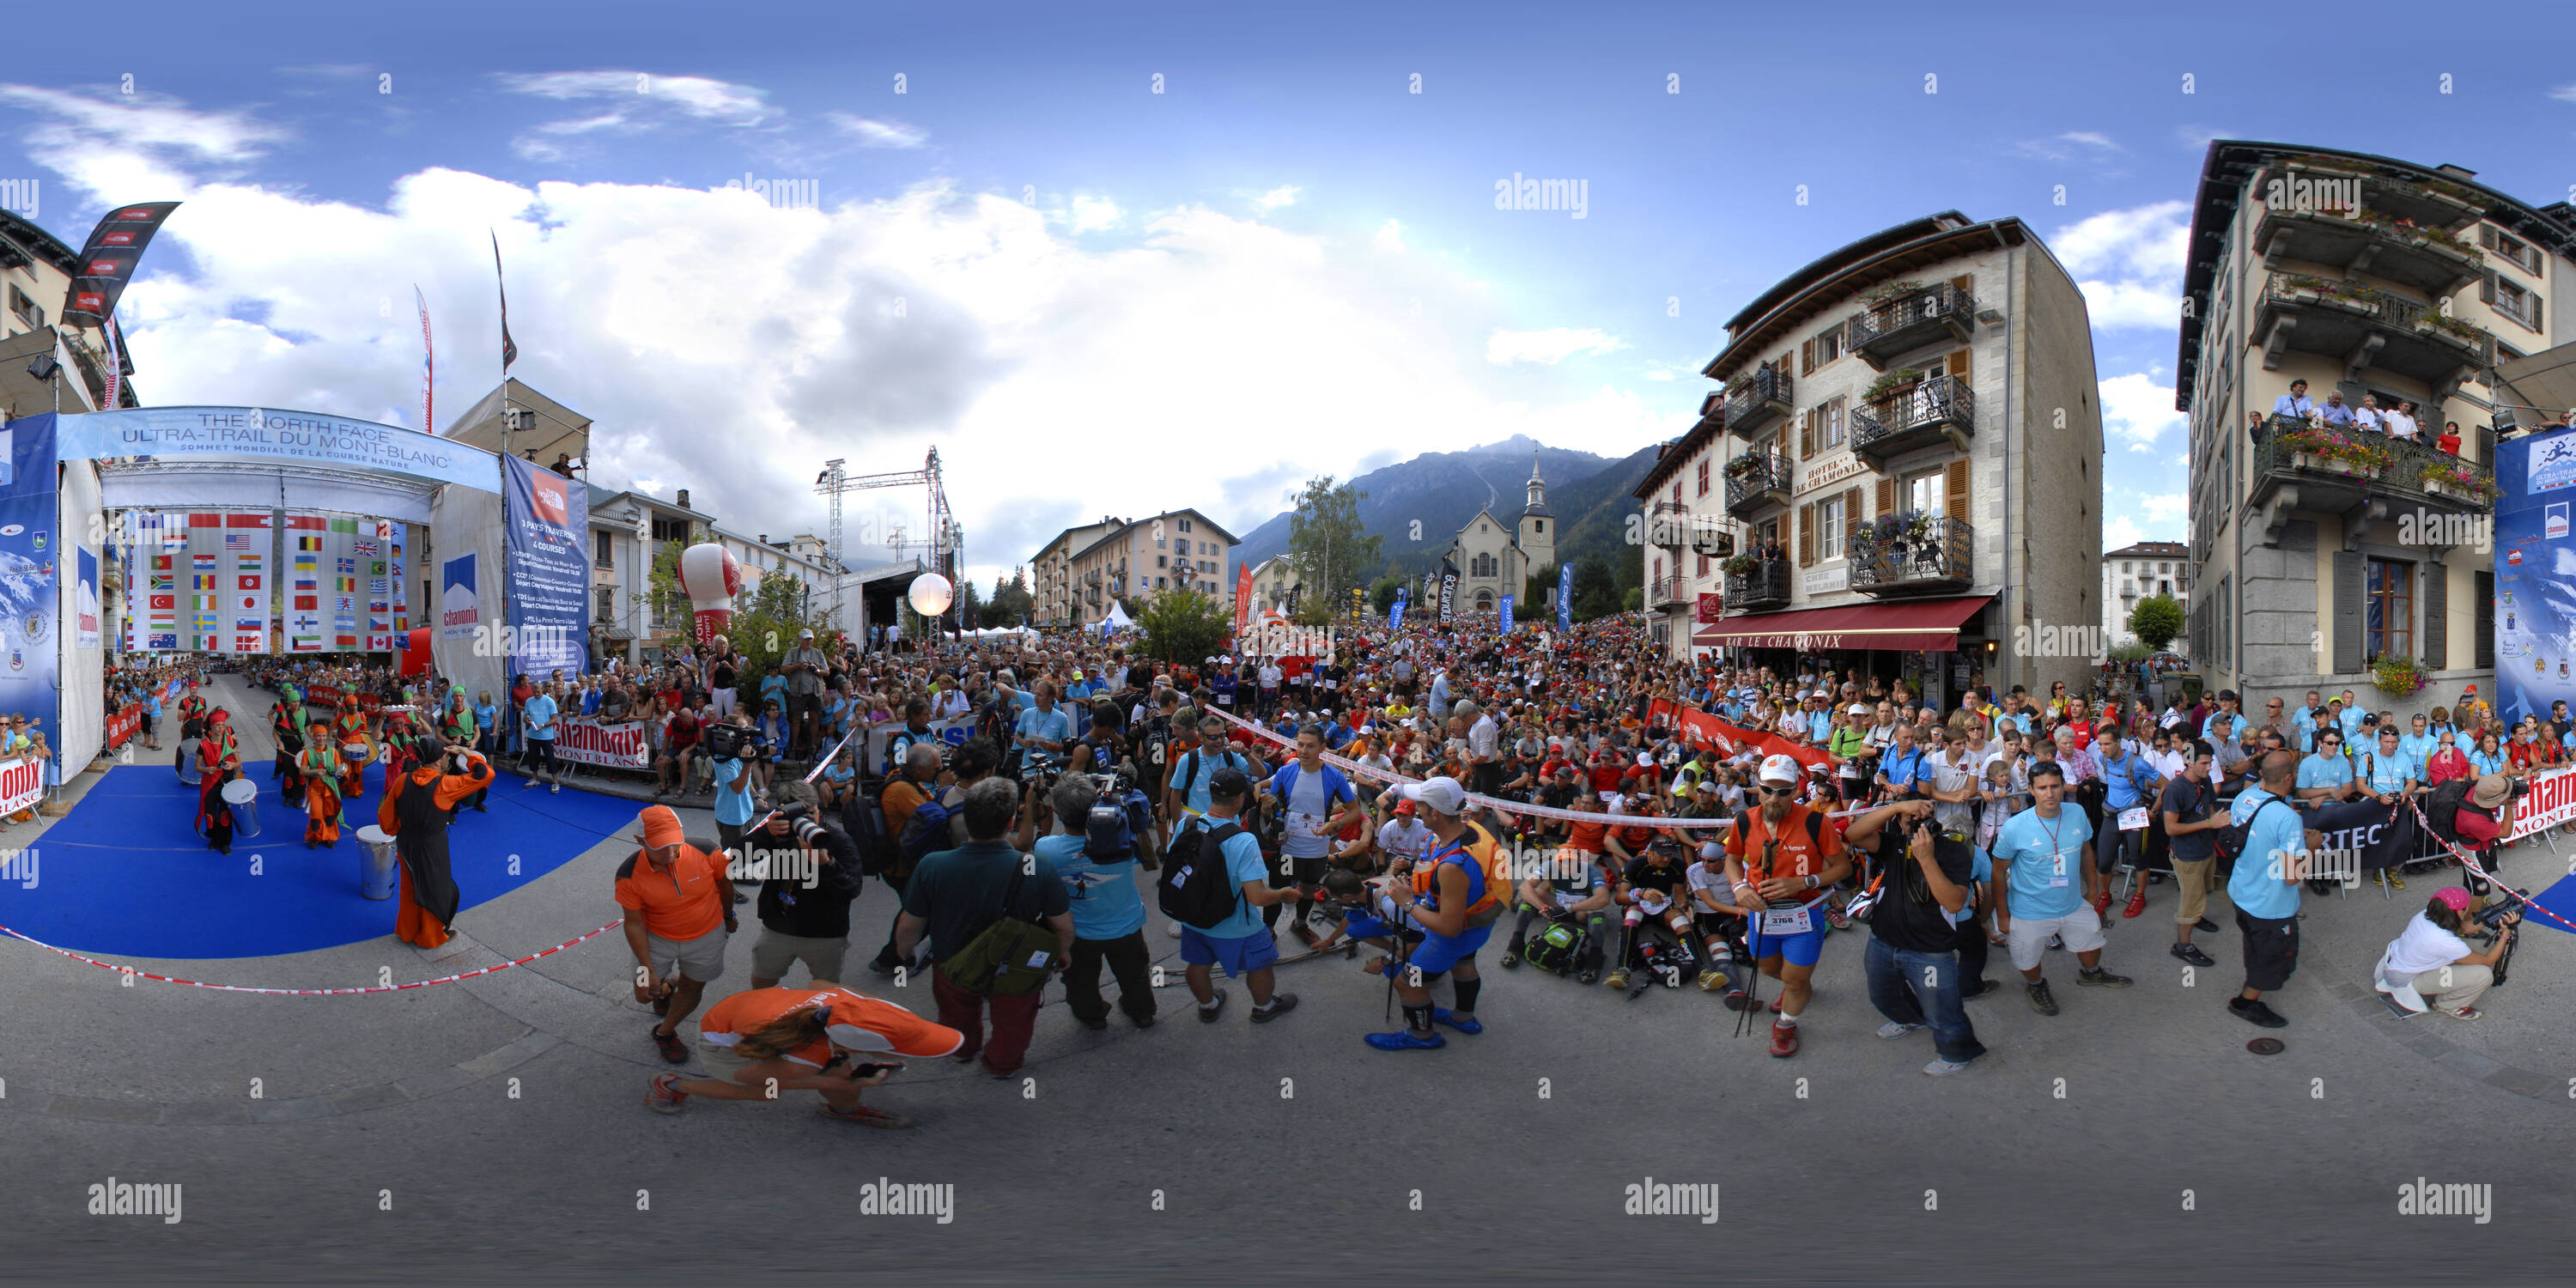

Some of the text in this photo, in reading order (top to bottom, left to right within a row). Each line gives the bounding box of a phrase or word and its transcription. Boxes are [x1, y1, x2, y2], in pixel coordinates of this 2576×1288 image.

[197, 414, 391, 443] THE NORTH FACE
[123, 428, 448, 469] ULTRA-TRAIL DU MONT-BLANC
[234, 446, 286, 454] MONDIAL
[326, 452, 368, 462] COURSE
[371, 457, 410, 470] NATURE
[1795, 462, 1864, 495] LE CHAMONIX
[1807, 459, 1839, 479] HOTEL
[526, 520, 544, 532] PAYS
[538, 542, 566, 555] COURSES
[1440, 574, 1456, 624] endurance
[1726, 635, 1843, 647] BAR LE CHAMONIX
[552, 720, 644, 756] chamonix
